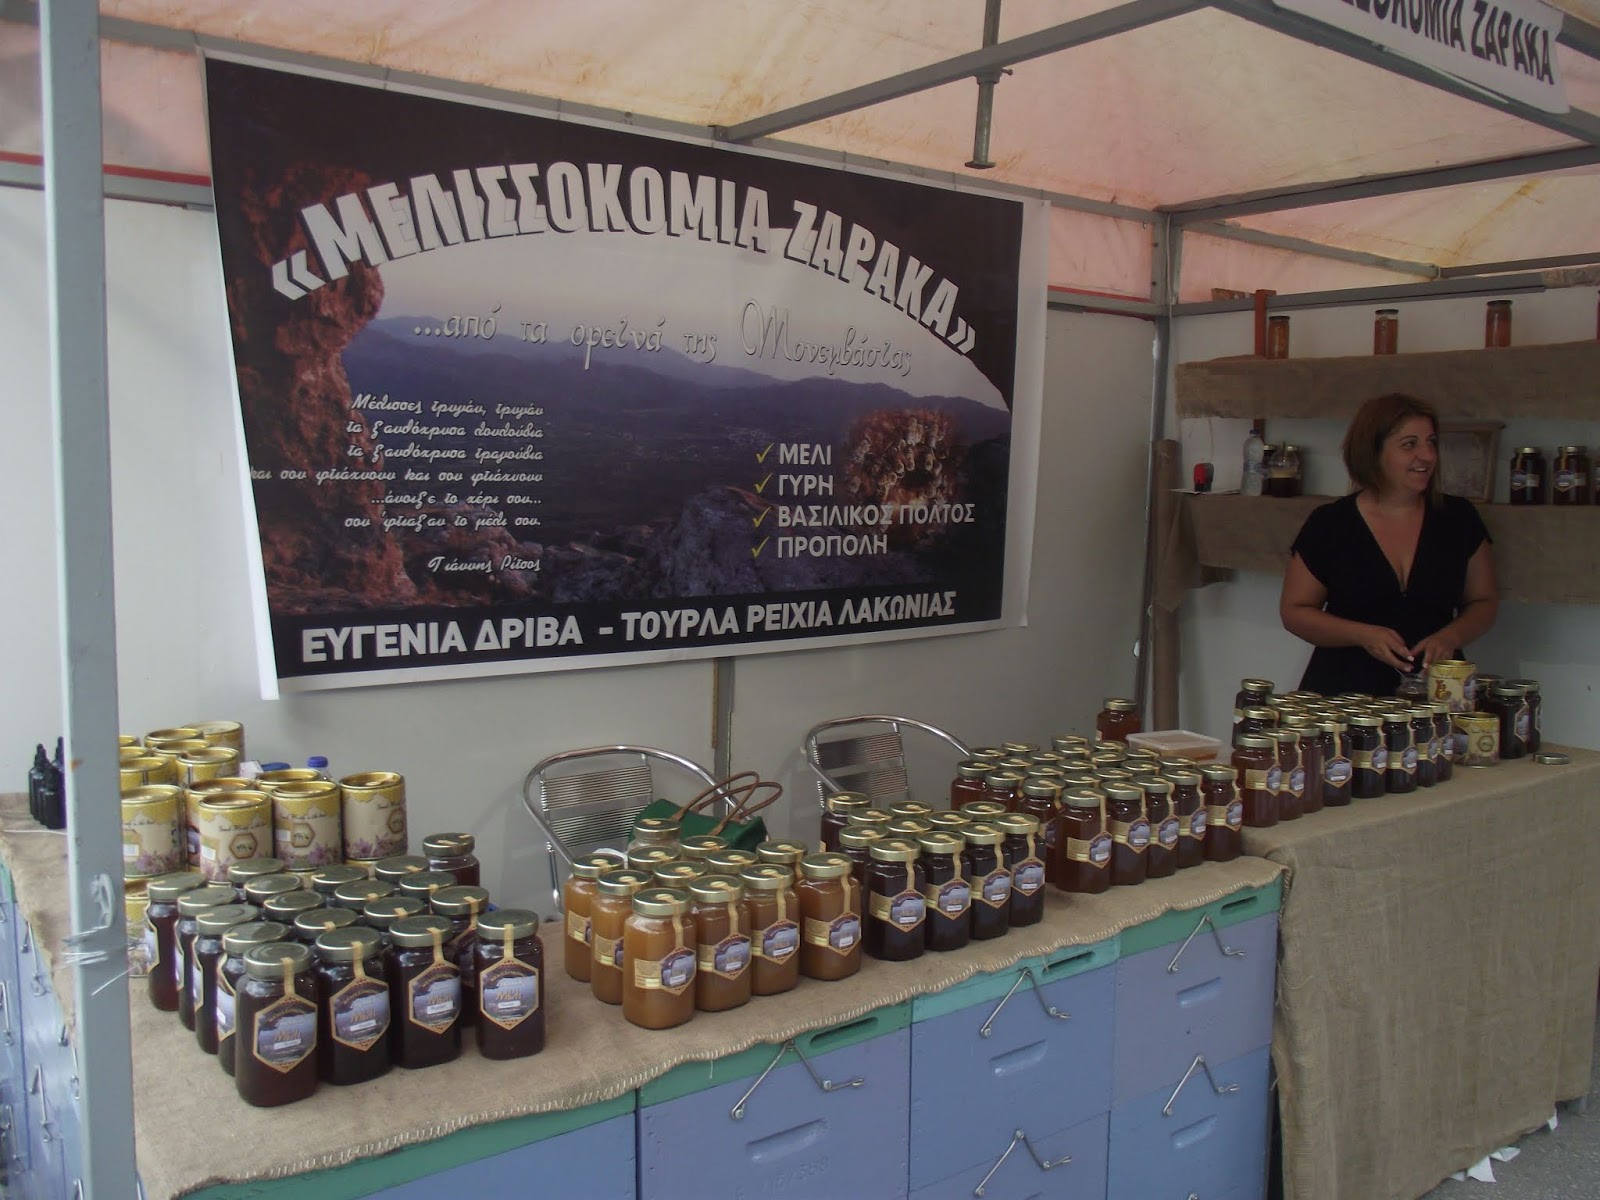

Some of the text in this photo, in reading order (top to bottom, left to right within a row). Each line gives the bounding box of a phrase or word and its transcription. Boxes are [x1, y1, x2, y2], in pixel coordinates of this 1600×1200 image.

[1342, 0, 1555, 86] ΚΟΜΙΑ ΖΑΡΑΚΑ
[272, 161, 977, 356] «ΜΕΛΙΣΣΟΚΟΜΙΑ ΖΑΡΑΚΑ»
[520, 320, 549, 344] τα
[684, 333, 718, 364] της
[346, 421, 363, 433] τα
[474, 421, 544, 438] λουλούδια
[347, 444, 364, 457] τα
[475, 444, 544, 464] τραγούδια
[779, 443, 832, 465] ΜΕΛΙ
[280, 469, 307, 480] σου
[404, 468, 431, 481] και
[438, 471, 463, 481] σου
[778, 474, 834, 496] ΓΥΡΗ
[444, 493, 459, 504] το
[466, 491, 500, 509] χέρι
[344, 517, 371, 527] σου
[454, 515, 468, 526] το
[475, 511, 507, 531] μέλι
[778, 503, 976, 527] ΒΑΣΙΛΙΚΟΣ ΠΟΛΤΟΣ
[777, 534, 888, 559] ΠΡΟΠΟΛΗ
[500, 554, 541, 571] Ρίτσος
[302, 620, 468, 663] ΕΥΓΕΝΙΑ
[474, 615, 584, 651] ΔΡΙΒΑ
[621, 606, 740, 641] ΤΟΥΡΛΑ
[747, 600, 830, 633] ΡΕΙΧΙΑ
[838, 591, 957, 625] ΛΑΚΩΝΙΑΣ
